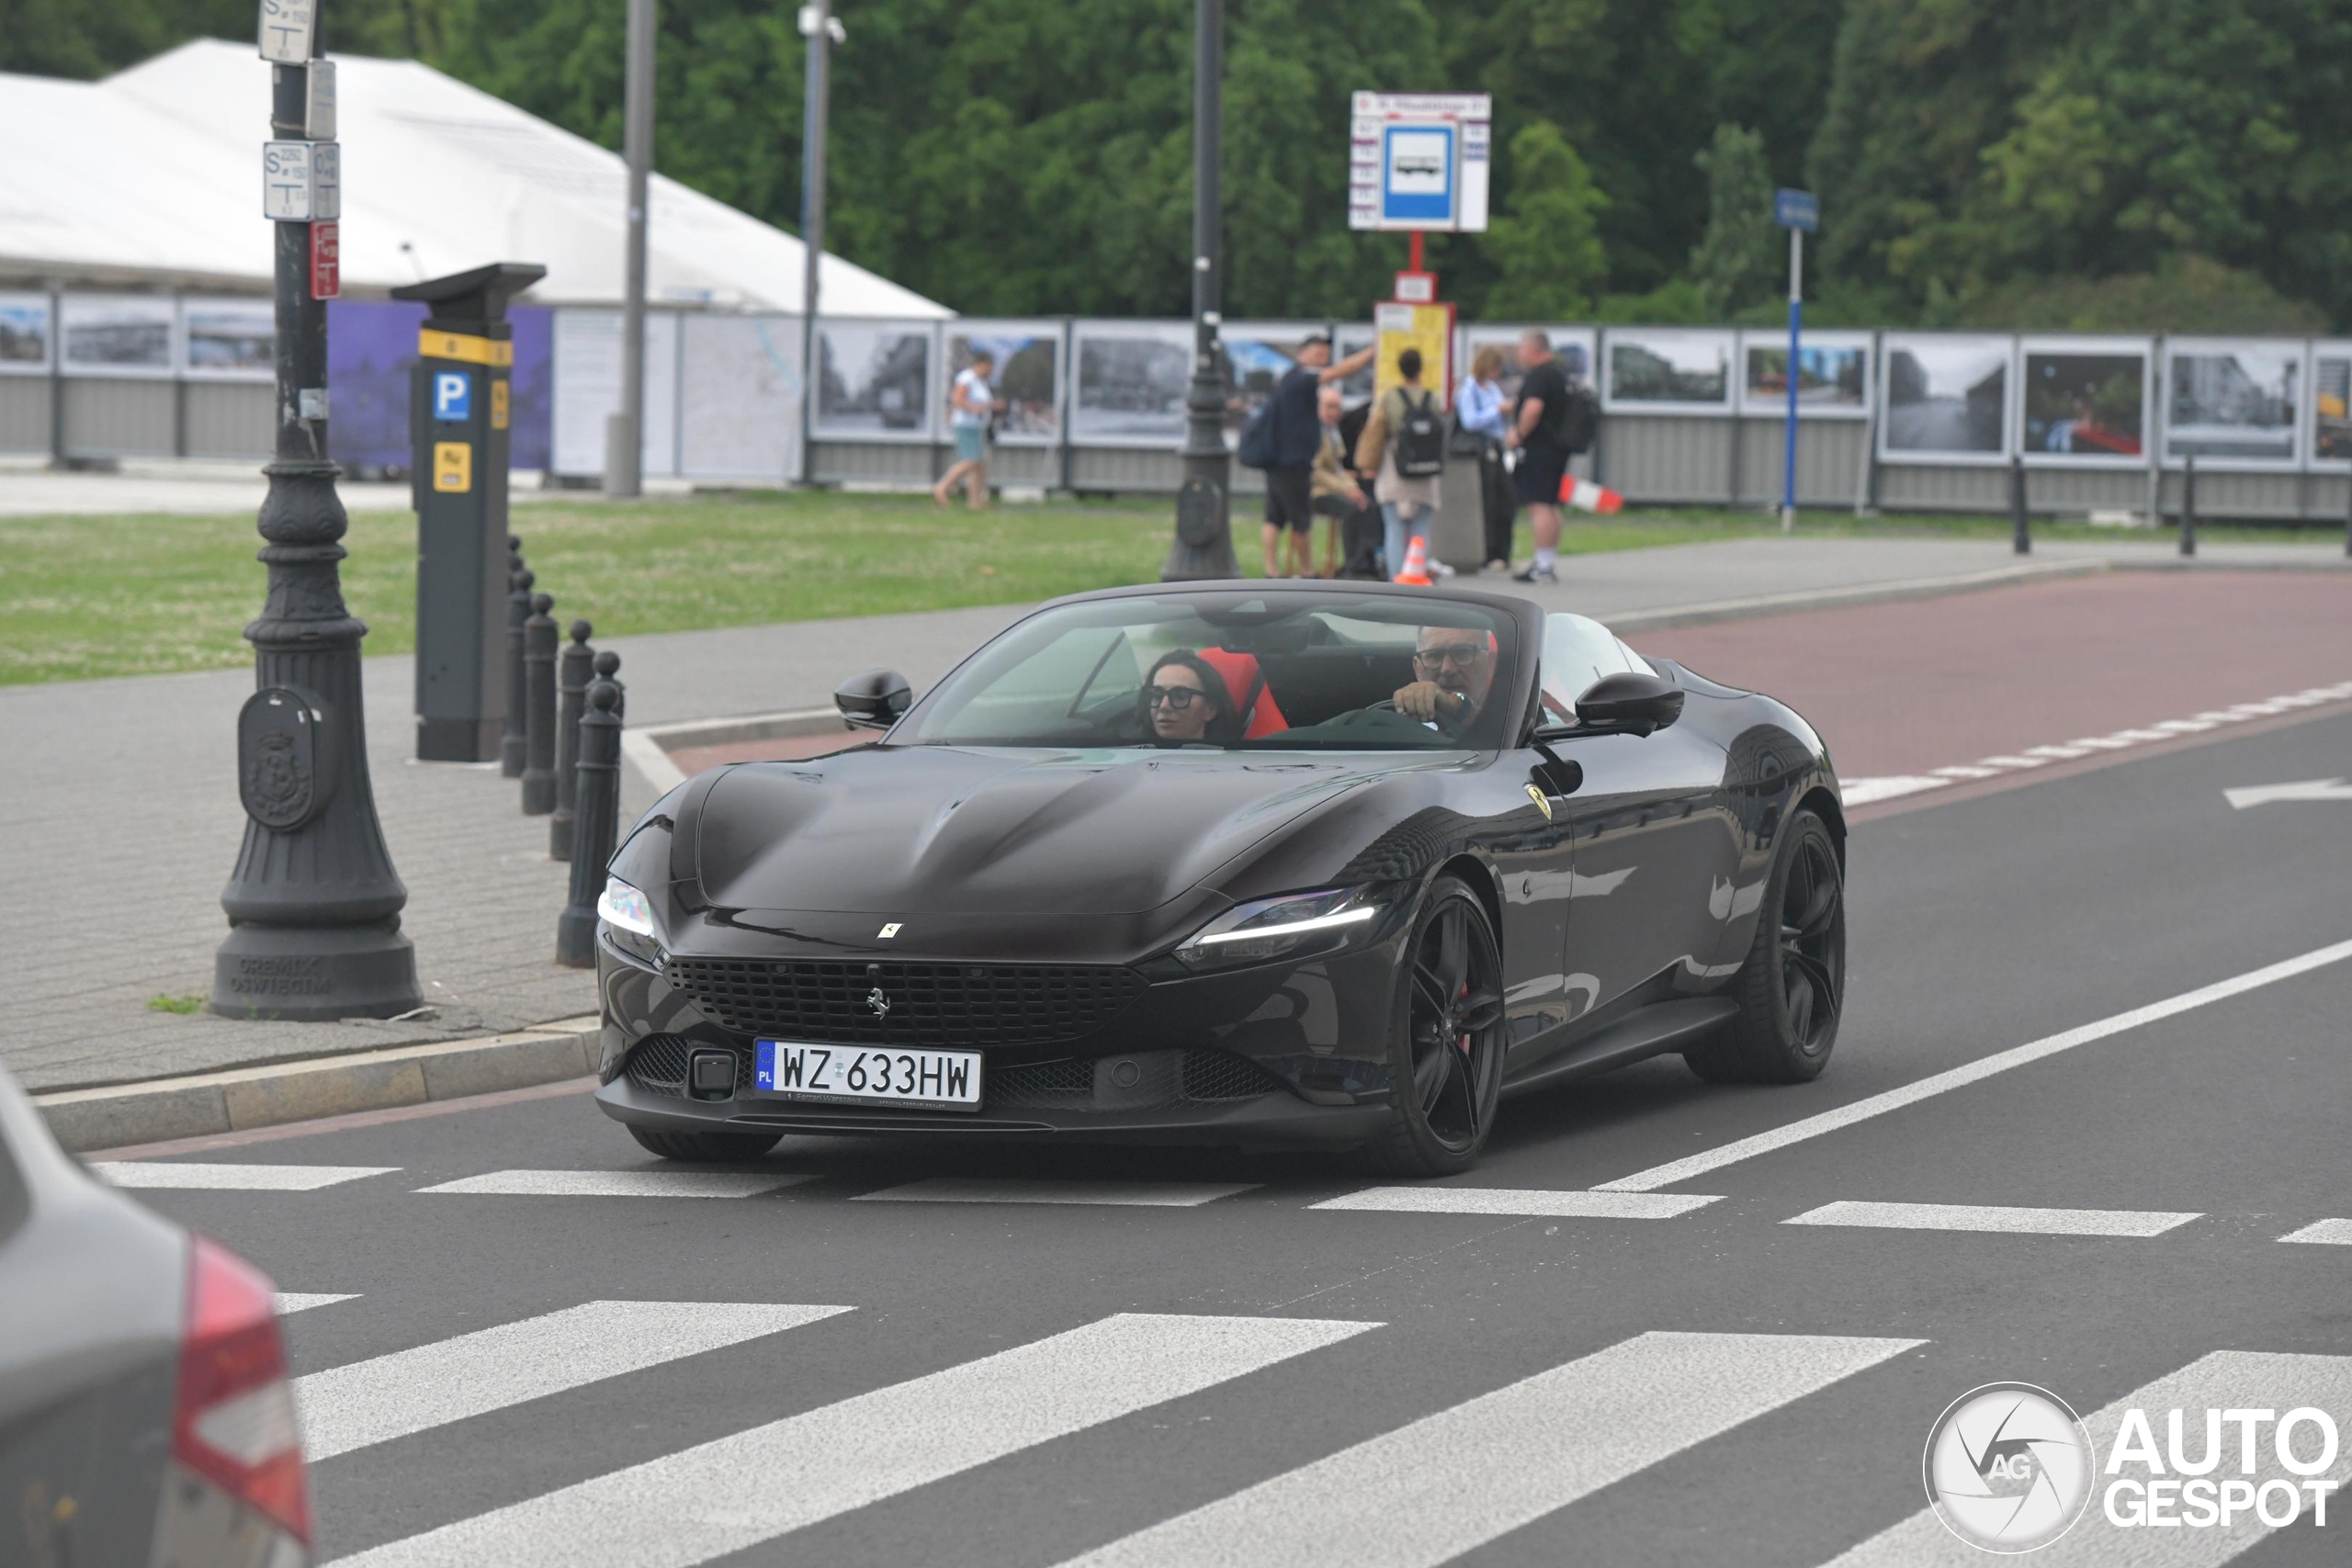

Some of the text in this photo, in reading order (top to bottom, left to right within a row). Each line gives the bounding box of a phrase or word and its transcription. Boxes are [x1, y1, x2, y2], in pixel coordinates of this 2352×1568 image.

[437, 374, 466, 412] P
[759, 1071, 772, 1083] PL
[784, 1047, 969, 1098] WZ 633HW
